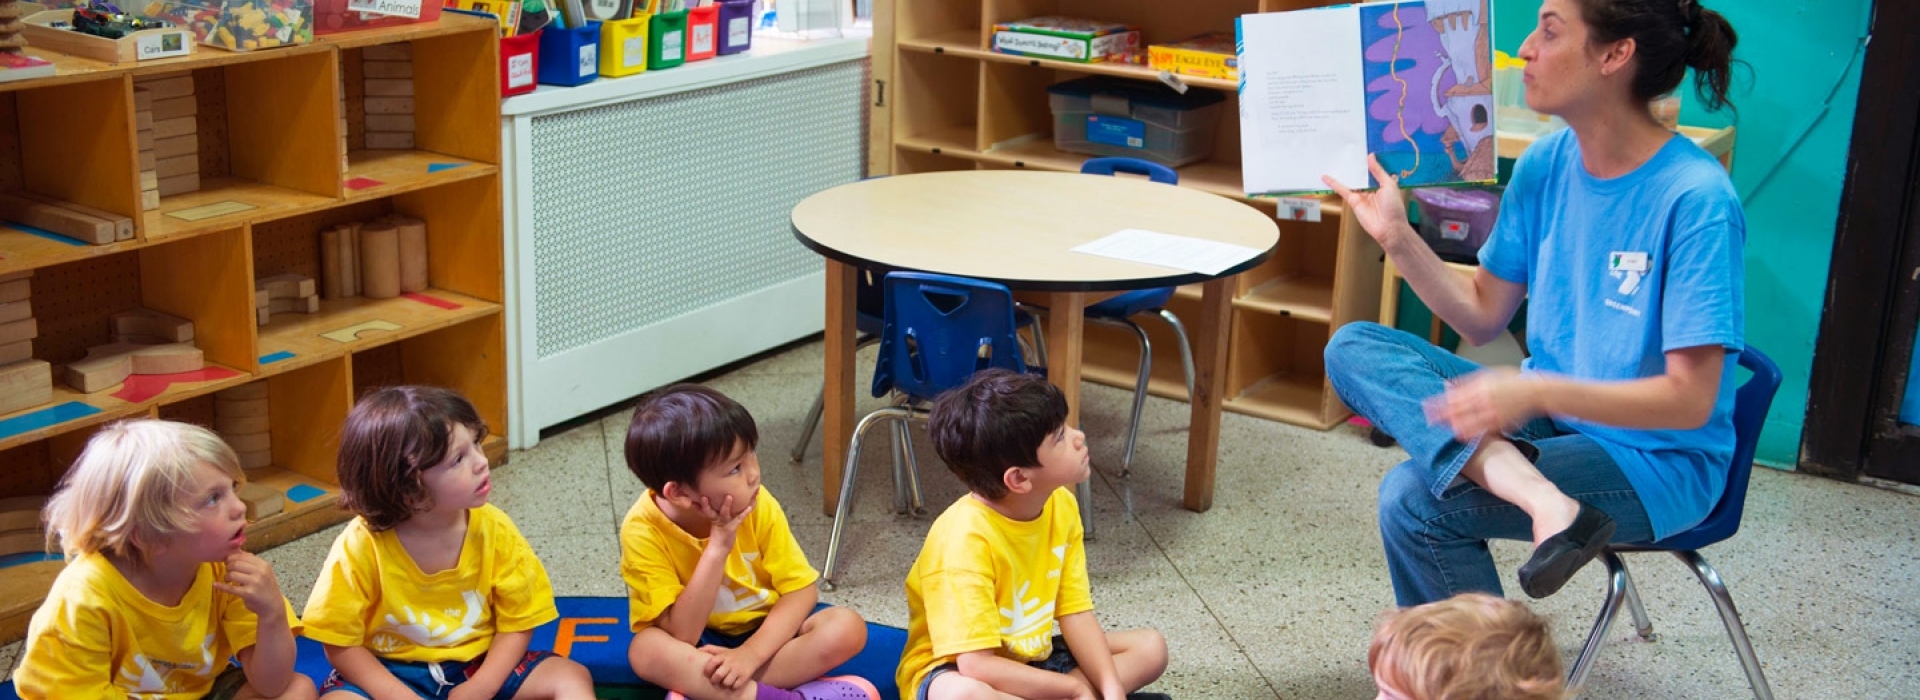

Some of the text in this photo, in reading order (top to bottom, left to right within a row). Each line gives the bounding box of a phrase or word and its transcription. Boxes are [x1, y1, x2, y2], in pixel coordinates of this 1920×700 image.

[378, 1, 420, 16] Animals
[143, 45, 161, 55] Cars
[1175, 54, 1201, 66] EAGLE
[1203, 58, 1221, 68] EYE
[443, 607, 462, 618] the
[553, 617, 619, 659] F
[1020, 633, 1052, 653] YMC
